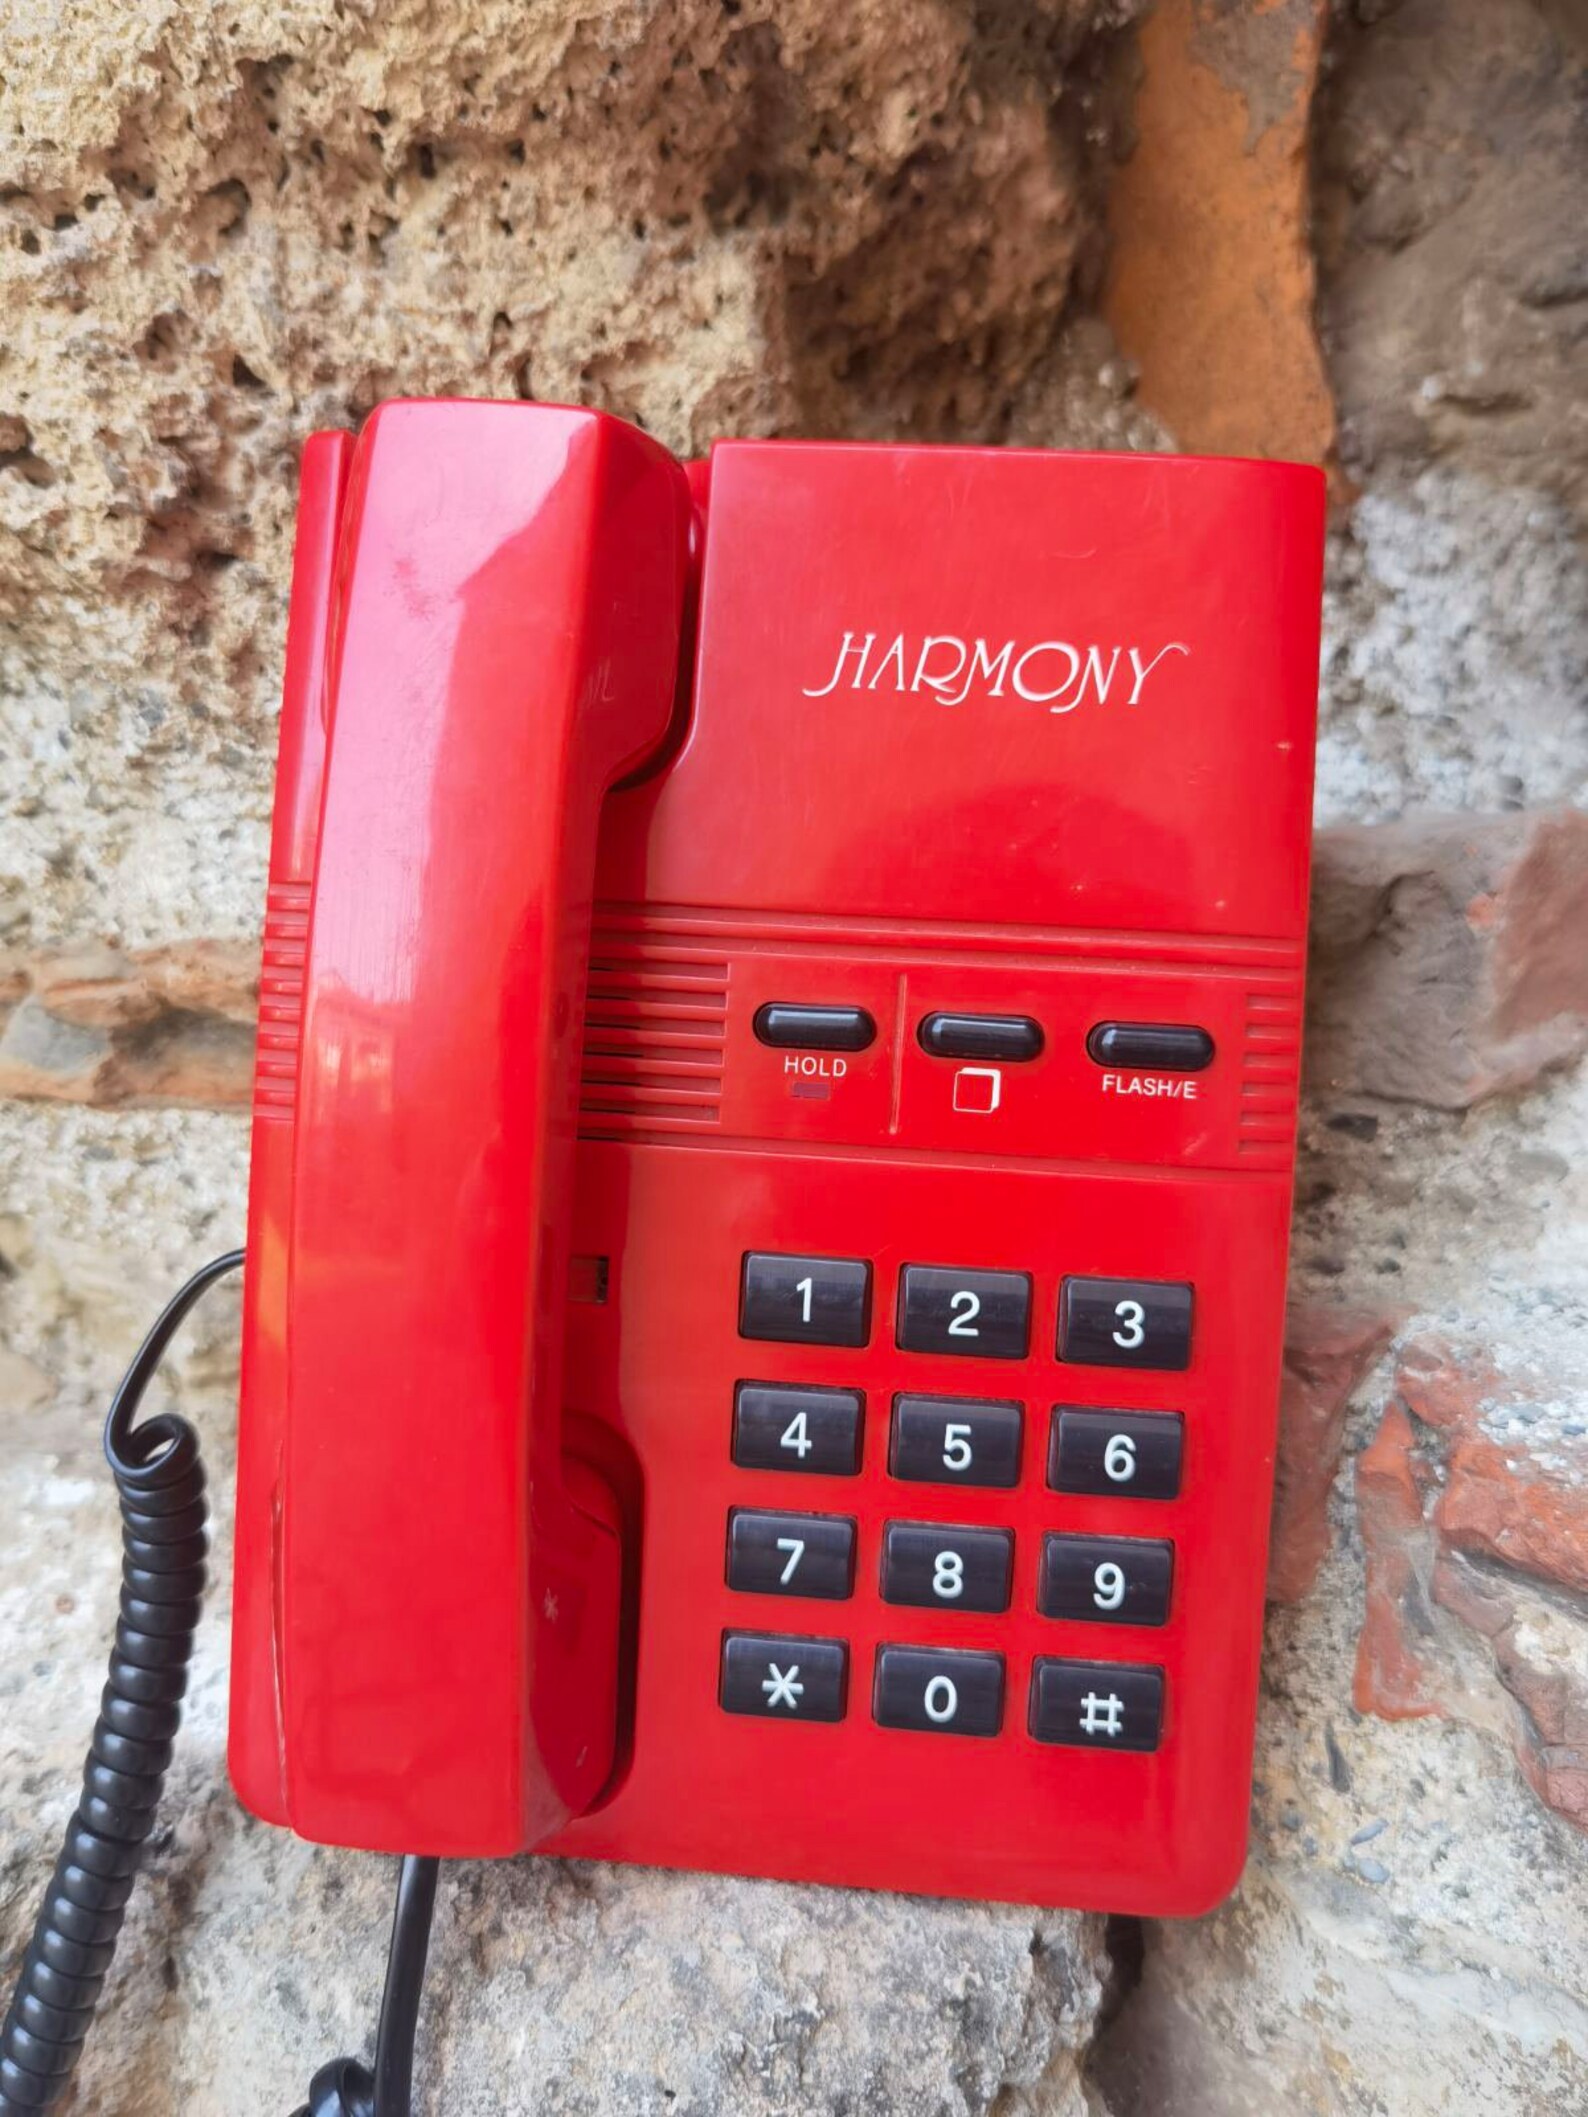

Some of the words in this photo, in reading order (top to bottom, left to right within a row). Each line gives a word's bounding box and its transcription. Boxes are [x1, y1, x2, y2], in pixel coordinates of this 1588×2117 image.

[802, 631, 1189, 714] HARMONY
[784, 1056, 847, 1077] HOLD
[1102, 1074, 1196, 1100] FLASH/E
[796, 1277, 813, 1322] 1
[948, 1291, 980, 1336] 2
[1113, 1300, 1145, 1348] 3
[780, 1411, 812, 1457] 4
[942, 1423, 972, 1470] 5
[1104, 1434, 1136, 1481] 6
[777, 1538, 804, 1583] 7
[932, 1550, 963, 1597] 8
[1094, 1562, 1125, 1609] 9
[924, 1676, 957, 1722] 0
